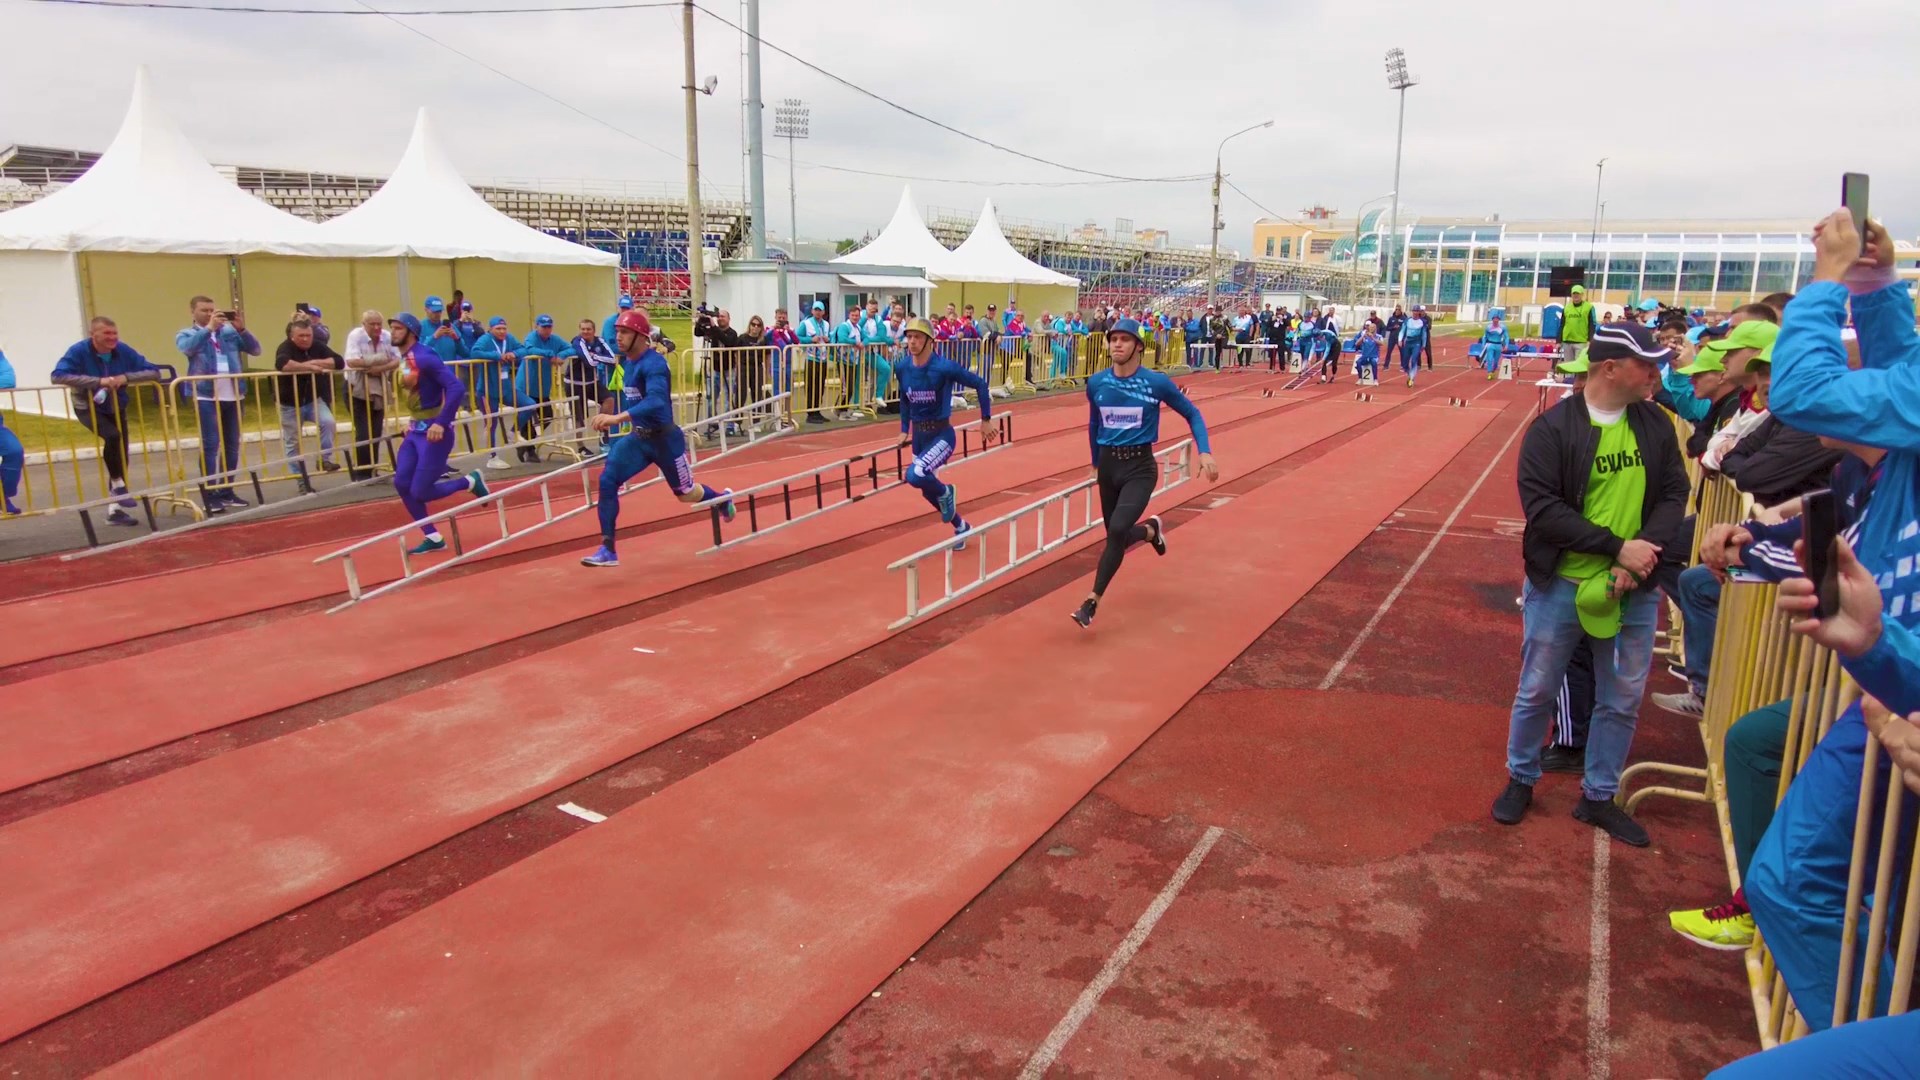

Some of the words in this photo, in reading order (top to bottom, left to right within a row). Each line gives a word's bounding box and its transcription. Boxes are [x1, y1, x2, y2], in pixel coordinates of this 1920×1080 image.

[1291, 358, 1299, 368] 4
[1363, 368, 1371, 380] 2
[1503, 364, 1509, 375] 1
